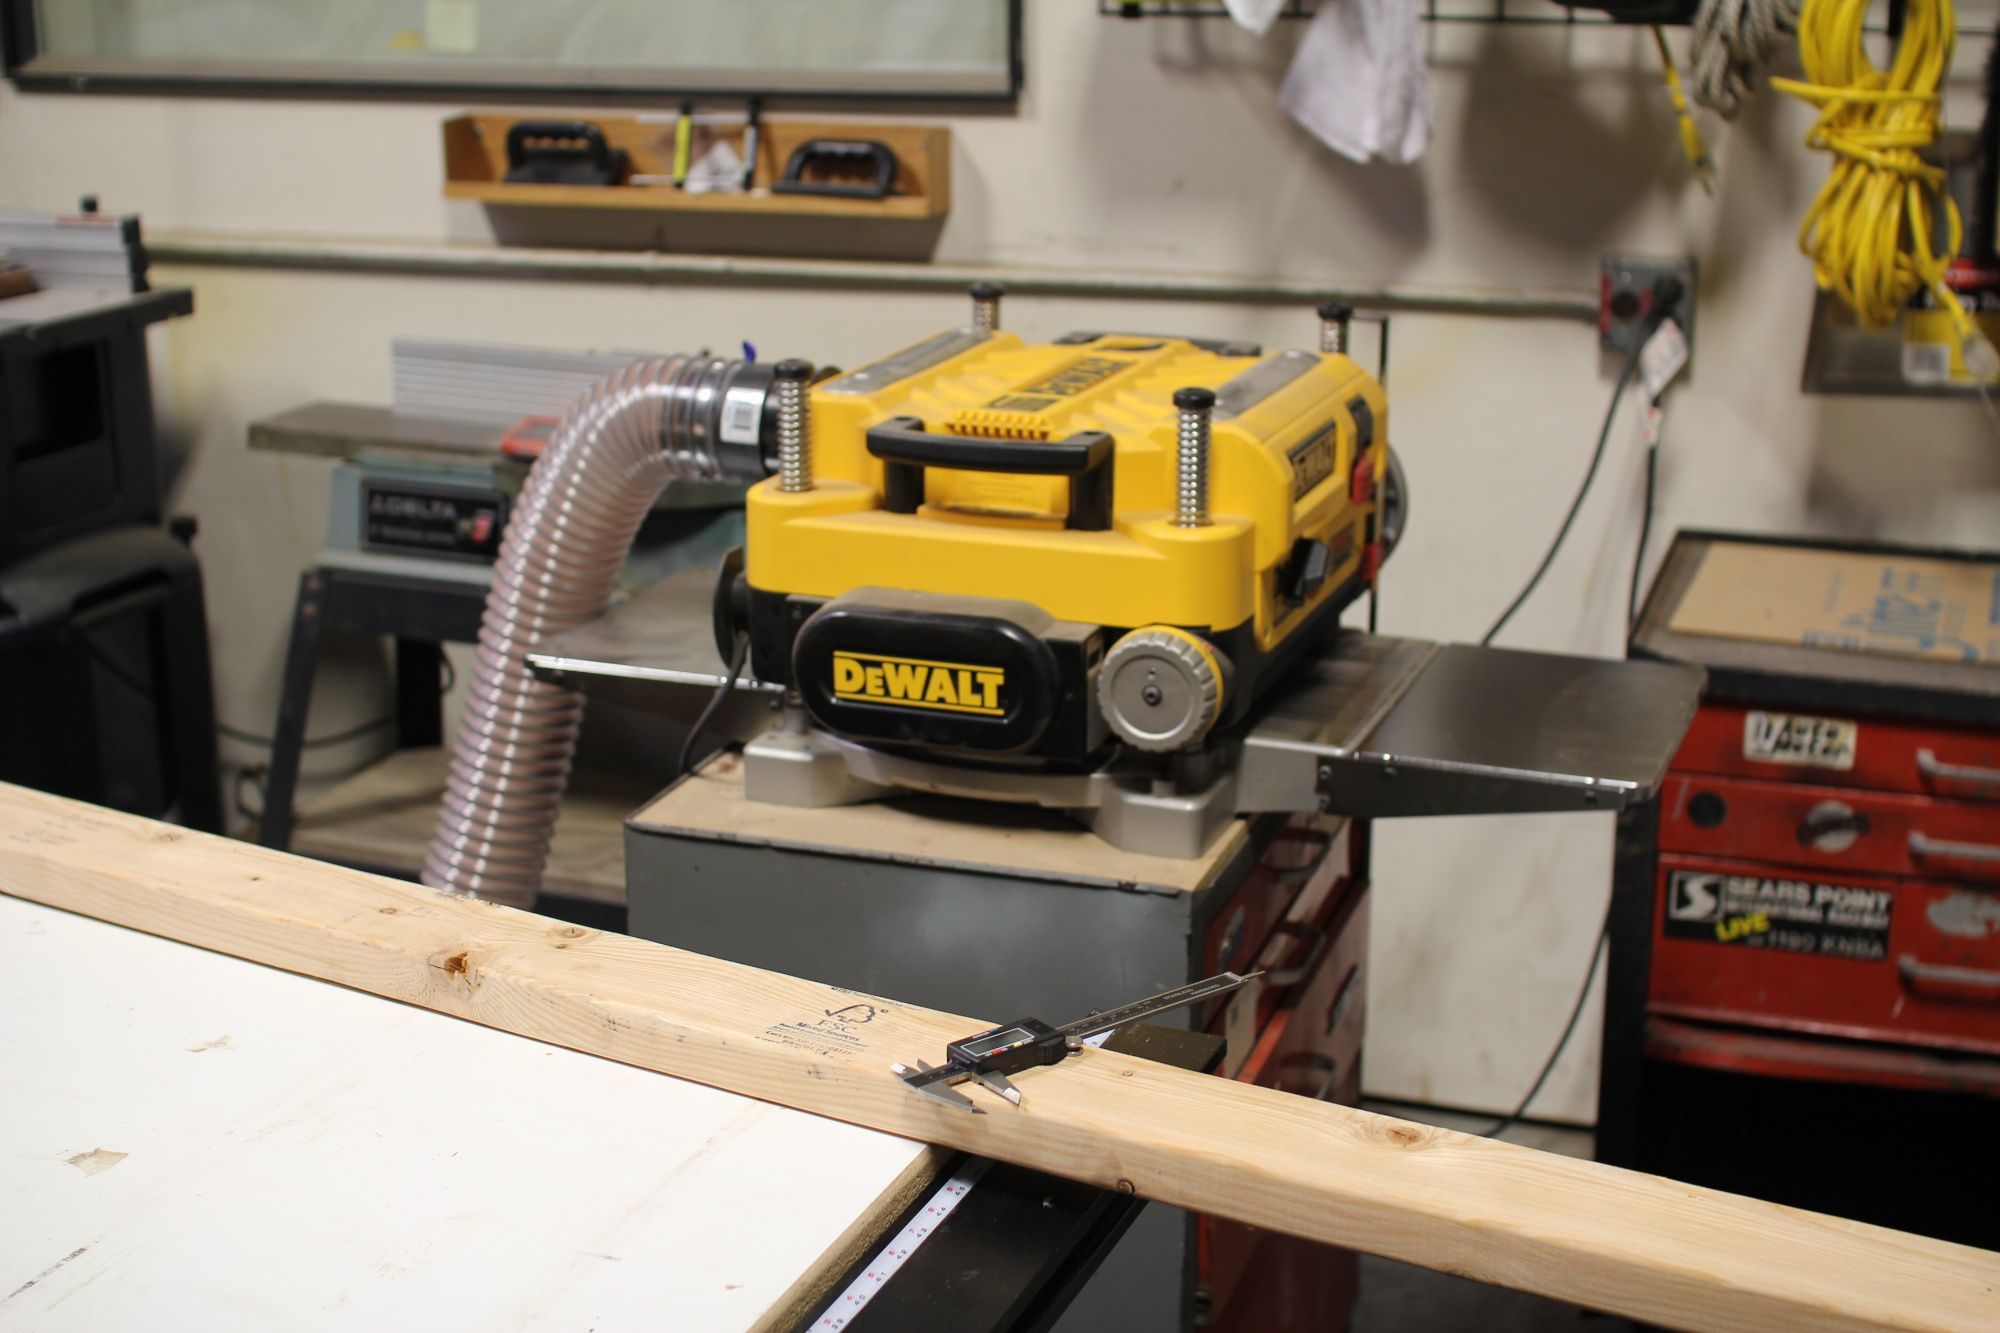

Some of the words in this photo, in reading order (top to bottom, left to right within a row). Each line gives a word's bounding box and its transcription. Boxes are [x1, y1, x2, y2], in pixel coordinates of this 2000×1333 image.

[833, 657, 1005, 709] DEWALT
[1727, 876, 1812, 901] SEARS
[1815, 885, 1892, 911] POINT
[795, 1021, 825, 1033] Mixed
[826, 1029, 861, 1042] Sources
[816, 1019, 858, 1034] FSC
